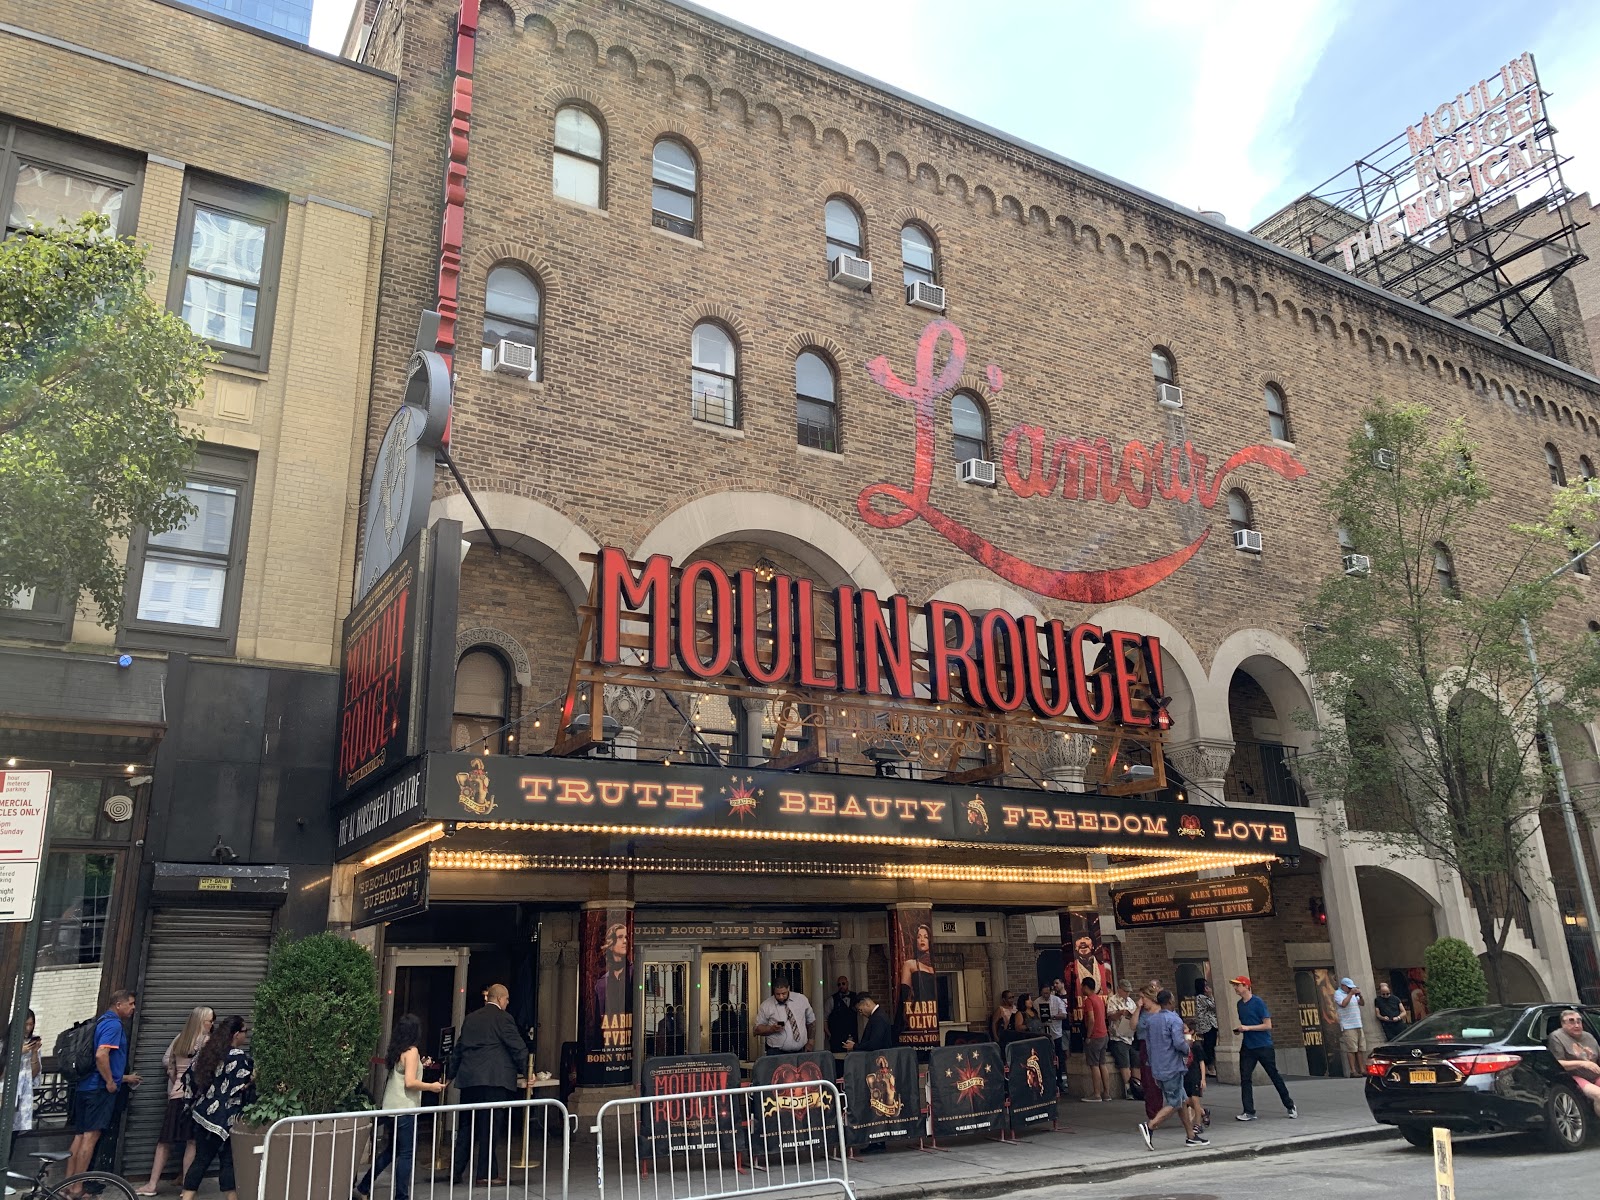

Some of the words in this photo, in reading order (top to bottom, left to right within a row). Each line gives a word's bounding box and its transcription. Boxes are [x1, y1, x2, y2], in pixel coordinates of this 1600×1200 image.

[1406, 51, 1537, 156] MOULIN
[1415, 88, 1543, 191] ROUGE!
[1335, 213, 1404, 272] THE
[1404, 132, 1554, 235] MUSICAL
[599, 546, 916, 699] MOULIN
[925, 600, 1171, 730] ROUGE!
[20, 808, 41, 816] ONLY
[338, 816, 349, 848] THE
[347, 812, 356, 843] AL
[391, 771, 421, 819] THEATRE
[519, 775, 705, 809] TRUTH
[779, 790, 947, 822] BEAUTY
[1002, 805, 1170, 836] FREEDOM
[1213, 819, 1289, 843] LOVE
[1133, 896, 1150, 906] JOHN
[1151, 894, 1175, 904] LOGAN
[1190, 890, 1211, 900] ALEX
[1212, 886, 1249, 897] TIMBERS
[1190, 906, 1219, 917] JUSTIN
[1221, 903, 1253, 914] LEVINE
[634, 926, 665, 935] ULIN
[720, 926, 749, 934] LIFE
[752, 926, 765, 934] IS
[944, 923, 956, 931] 302
[910, 1015, 938, 1029] OLIVO
[1299, 1008, 1320, 1026] LIVE
[898, 1035, 940, 1043] SENSATIO
[587, 1053, 613, 1062] BORN
[616, 1053, 626, 1061] TO
